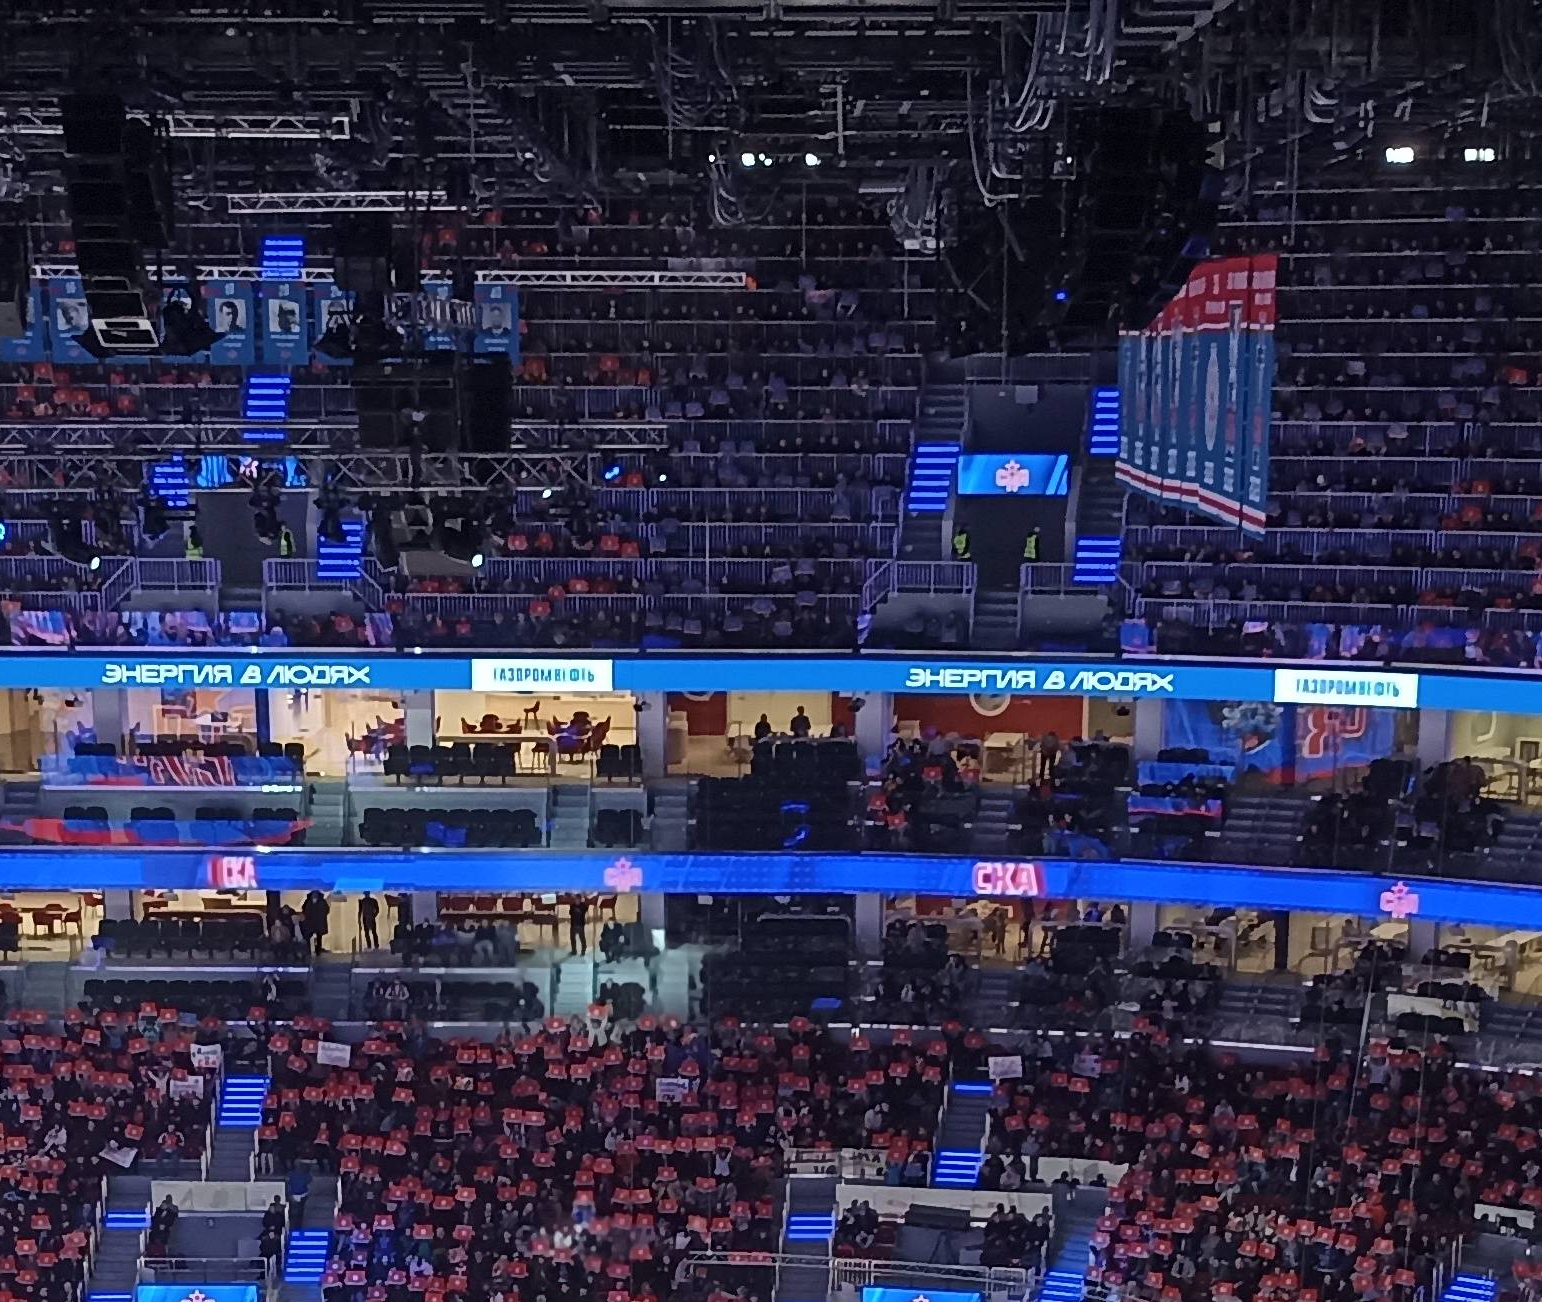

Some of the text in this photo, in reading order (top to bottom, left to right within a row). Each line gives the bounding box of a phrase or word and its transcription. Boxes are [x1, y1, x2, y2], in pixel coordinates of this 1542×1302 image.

[102, 663, 371, 685] ЭНЕРГИЯ В ЛЮДЯХ
[905, 668, 1174, 692] ЭНЕРГИЯ В ЛЮДЯХ
[972, 862, 1039, 896] СКА
